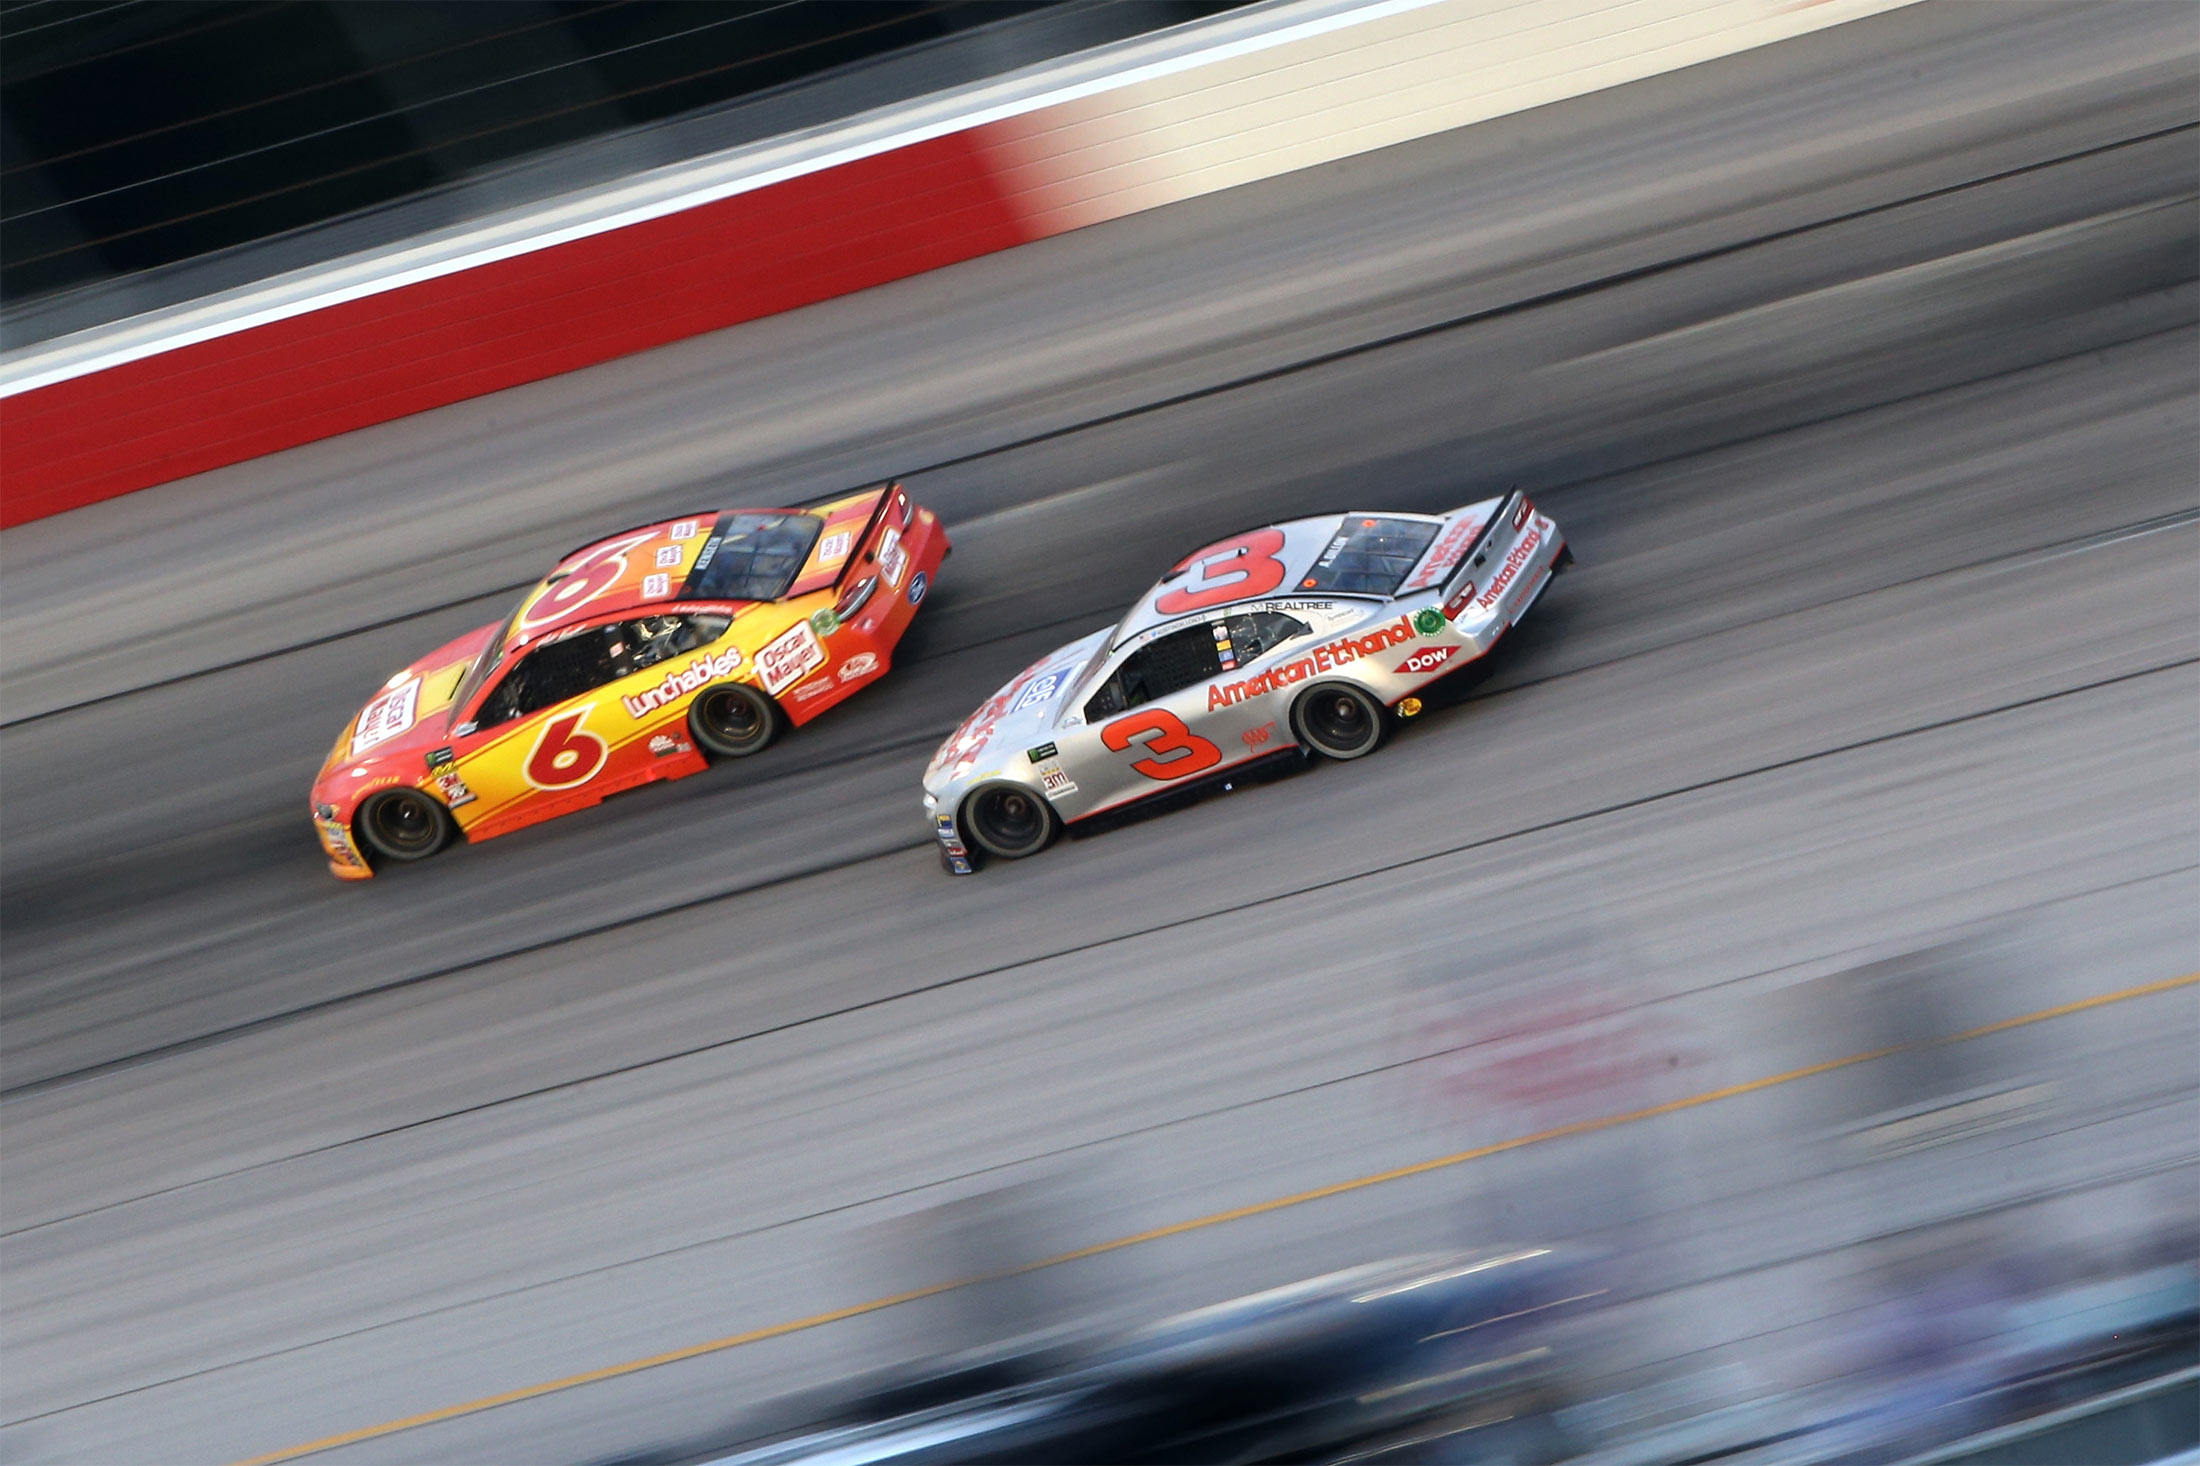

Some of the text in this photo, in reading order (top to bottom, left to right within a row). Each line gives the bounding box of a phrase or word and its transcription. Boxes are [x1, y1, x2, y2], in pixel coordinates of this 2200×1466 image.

[522, 530, 660, 629] 6
[1155, 528, 1286, 616] 3
[1265, 601, 1333, 611] REALTREE
[764, 630, 806, 668] Oscar
[767, 642, 817, 687] Mayer
[1208, 655, 1316, 712] American
[1313, 615, 1416, 673] Ethanol
[522, 701, 609, 791] 6
[1101, 708, 1222, 780] 3
